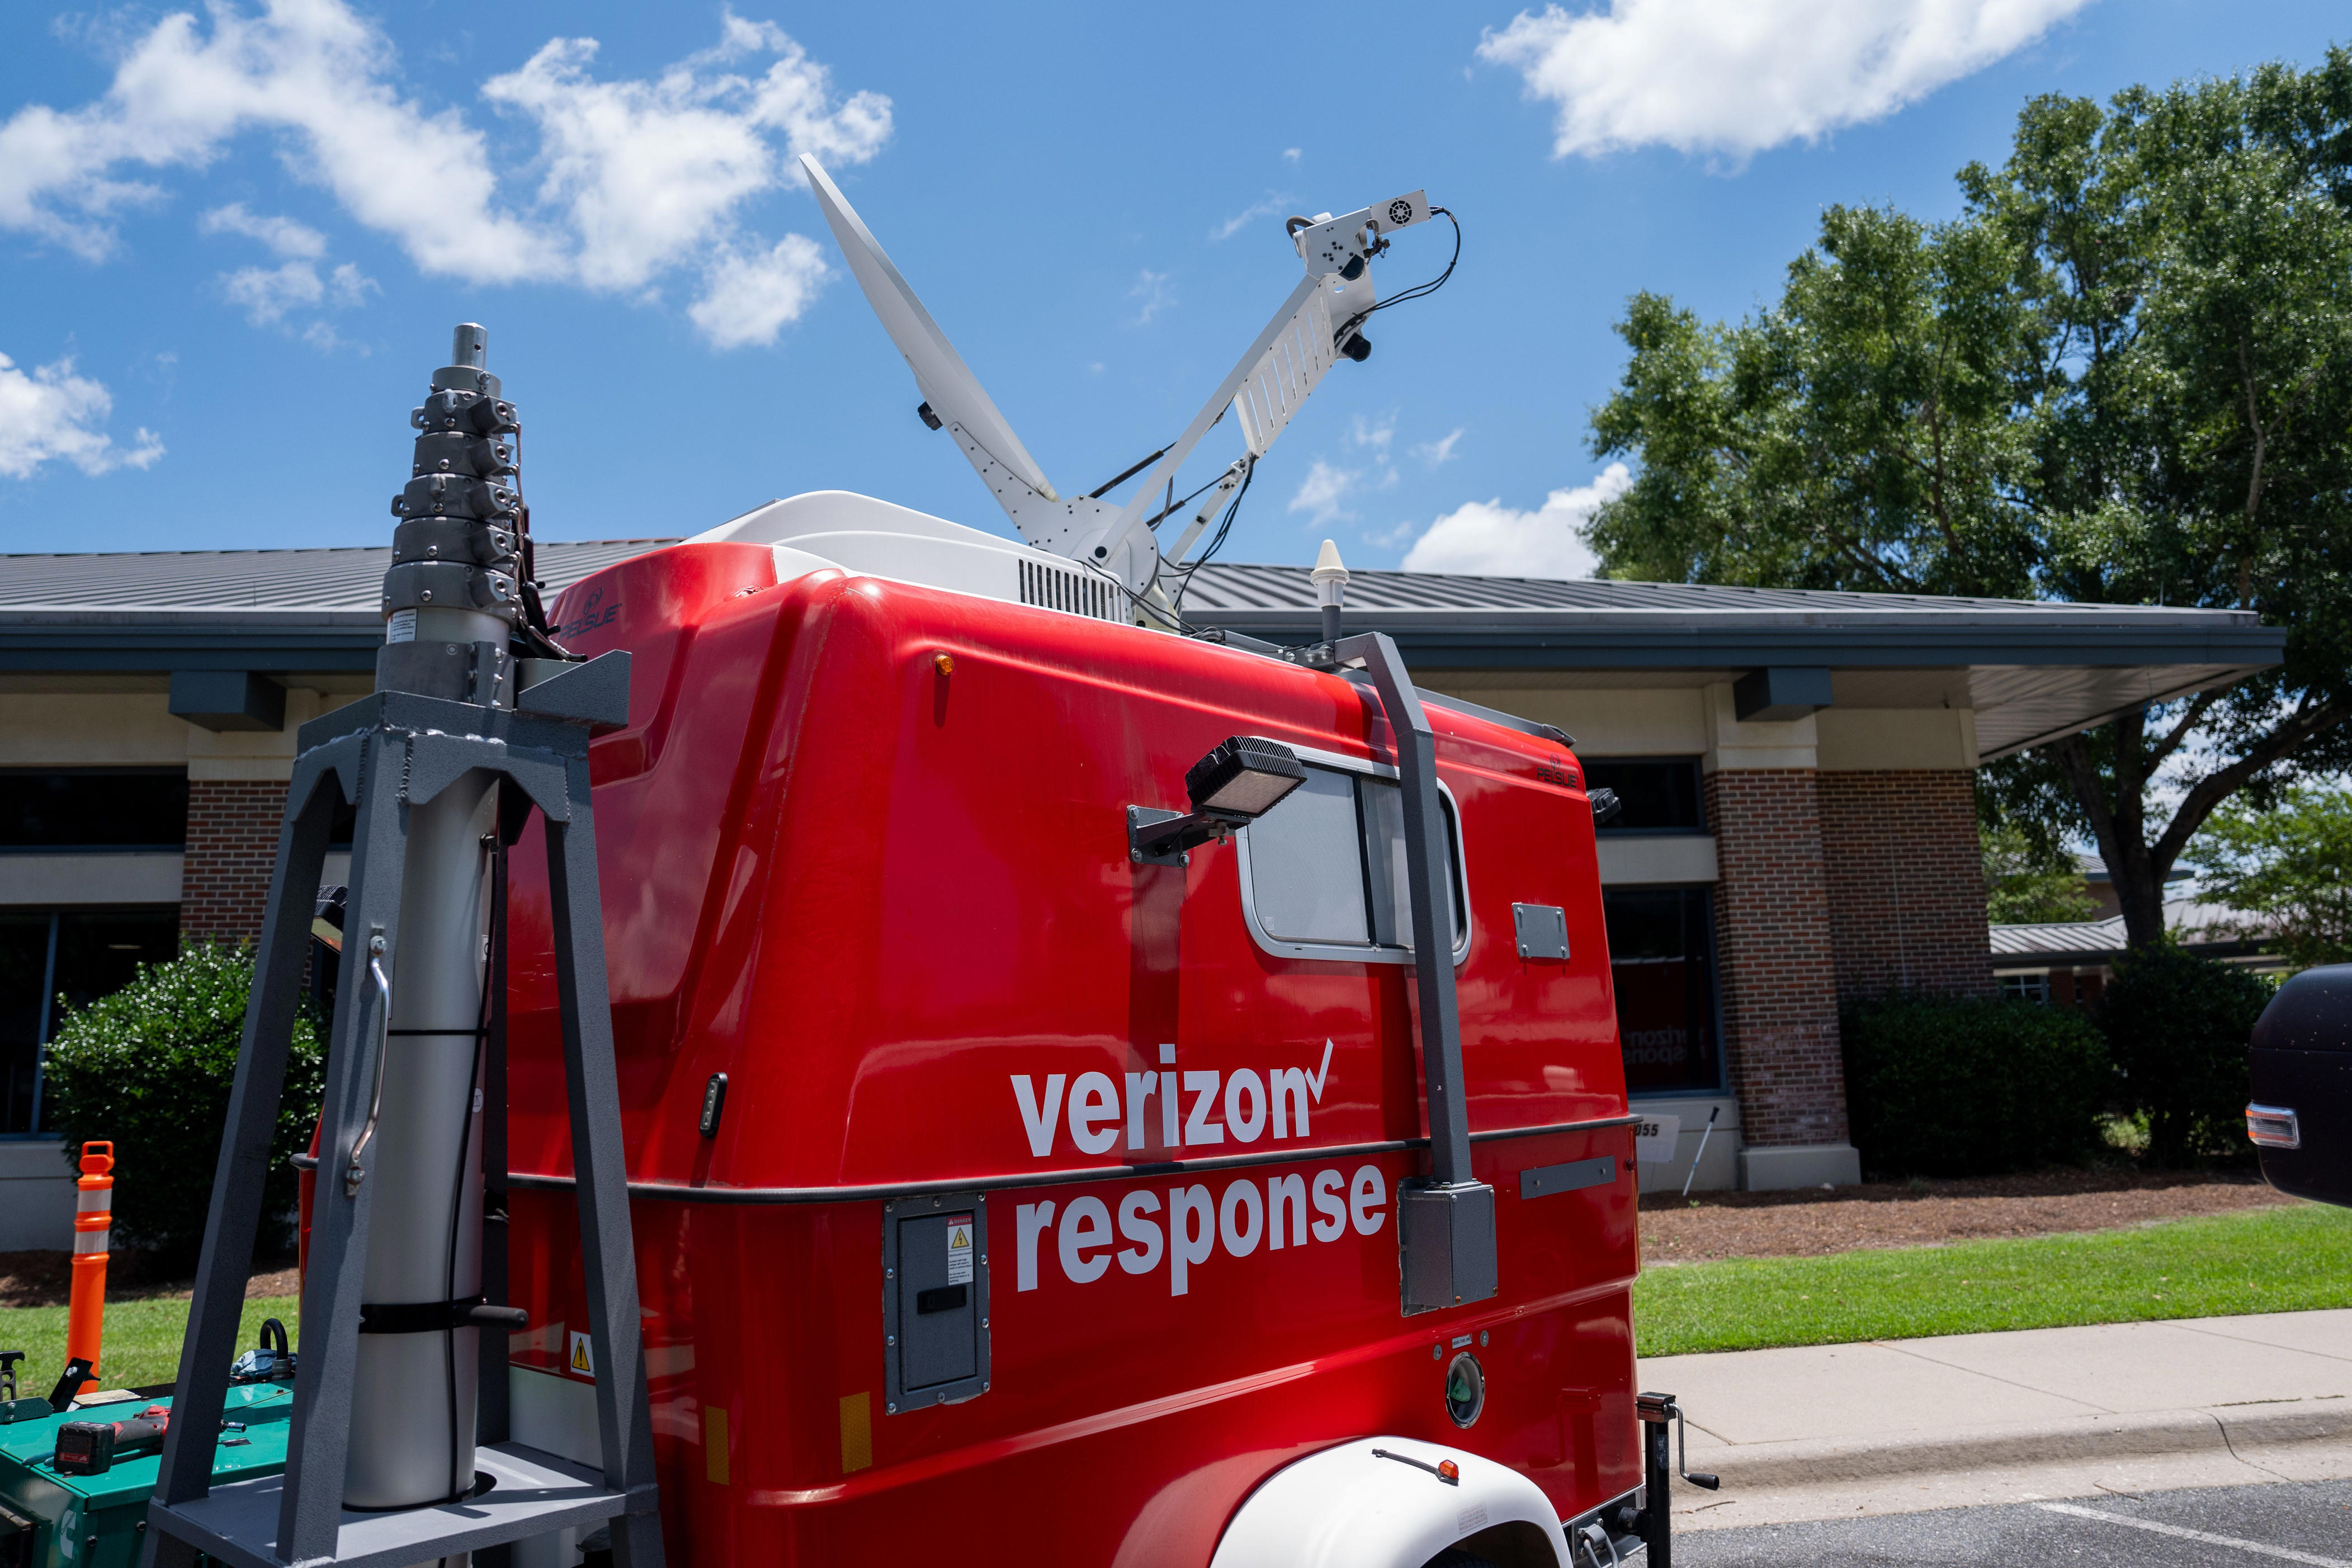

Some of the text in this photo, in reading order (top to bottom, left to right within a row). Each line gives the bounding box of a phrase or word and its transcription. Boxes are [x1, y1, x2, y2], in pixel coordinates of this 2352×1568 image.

[558, 604, 619, 643] PELSUE
[1537, 767, 1577, 788] PELSUE
[1010, 1043, 1310, 1157] verizon
[1016, 1165, 1387, 1297] response
